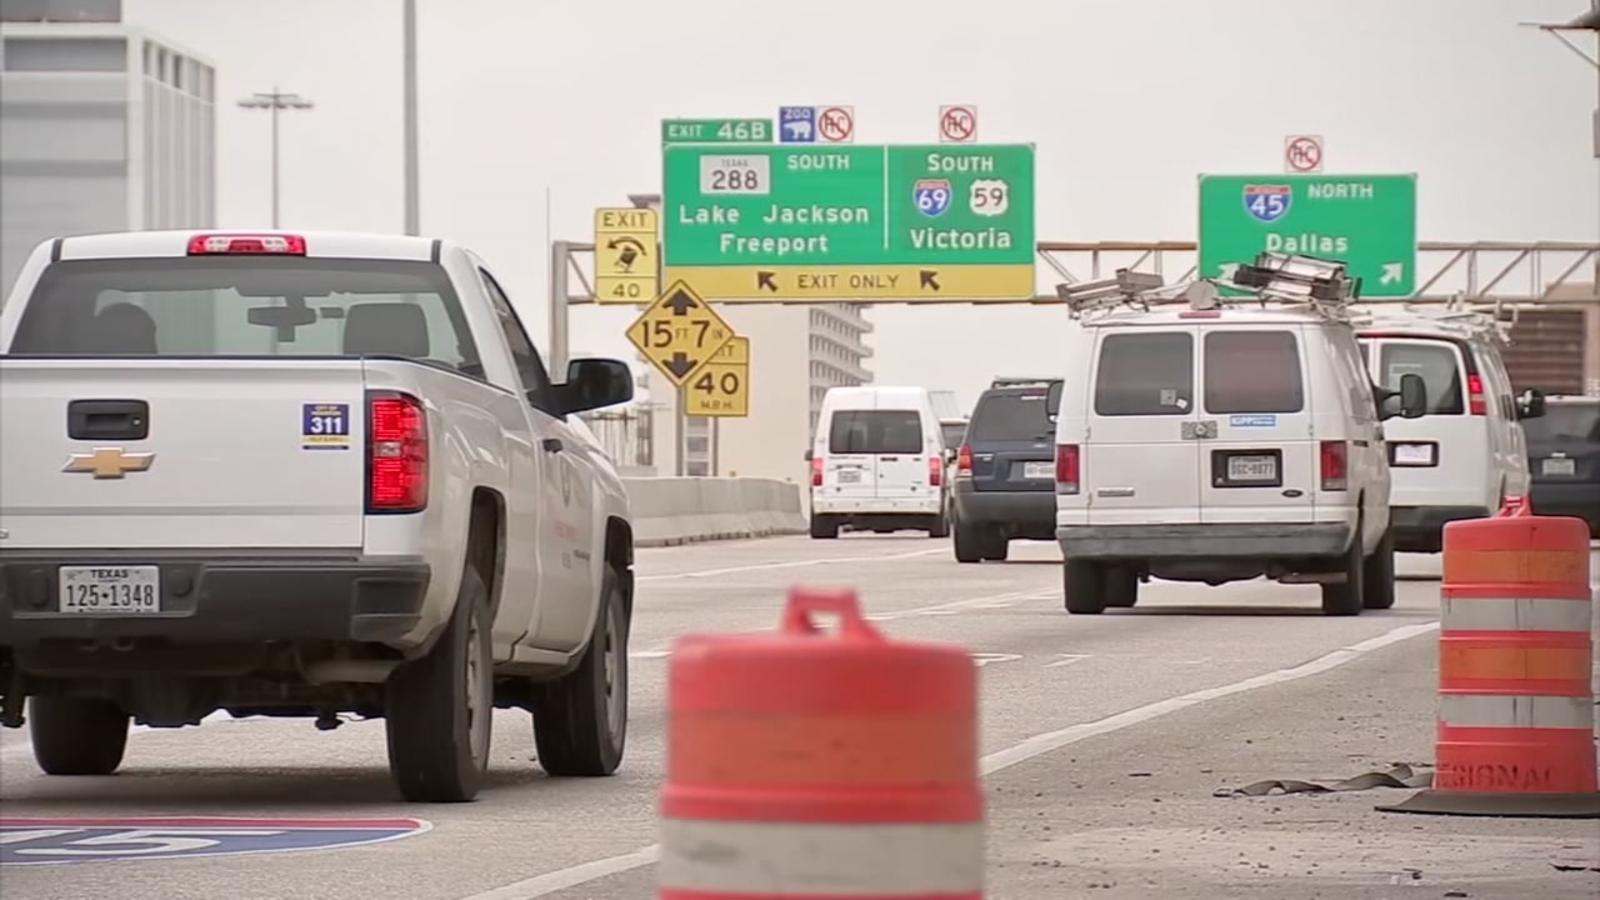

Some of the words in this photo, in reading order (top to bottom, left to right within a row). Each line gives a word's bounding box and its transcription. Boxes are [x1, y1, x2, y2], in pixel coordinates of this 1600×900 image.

[784, 109, 812, 120] ZOO
[668, 124, 703, 138] EXIT
[716, 121, 766, 140] 46B
[787, 154, 850, 170] SOUTH
[926, 153, 994, 172] SOUTH
[711, 169, 759, 191] 288
[918, 188, 948, 210] 69
[973, 187, 1004, 208] 59
[1307, 183, 1374, 199] NORTH
[679, 204, 741, 224] Lake
[762, 203, 870, 224] Jackson
[1251, 194, 1284, 215] 45
[602, 212, 648, 228] EXIT
[720, 233, 829, 256] Freeport
[909, 227, 1012, 249] Victoria
[1266, 233, 1348, 253] Dallas
[612, 282, 641, 298] 40
[797, 273, 839, 289] EXIT
[849, 273, 899, 289] ONLY
[641, 319, 673, 348] 15
[675, 328, 689, 339] FT
[691, 320, 711, 348] 7
[711, 329, 724, 339] IN
[693, 371, 739, 396] 40
[310, 416, 342, 434] 311
[90, 569, 129, 579] TEXAS
